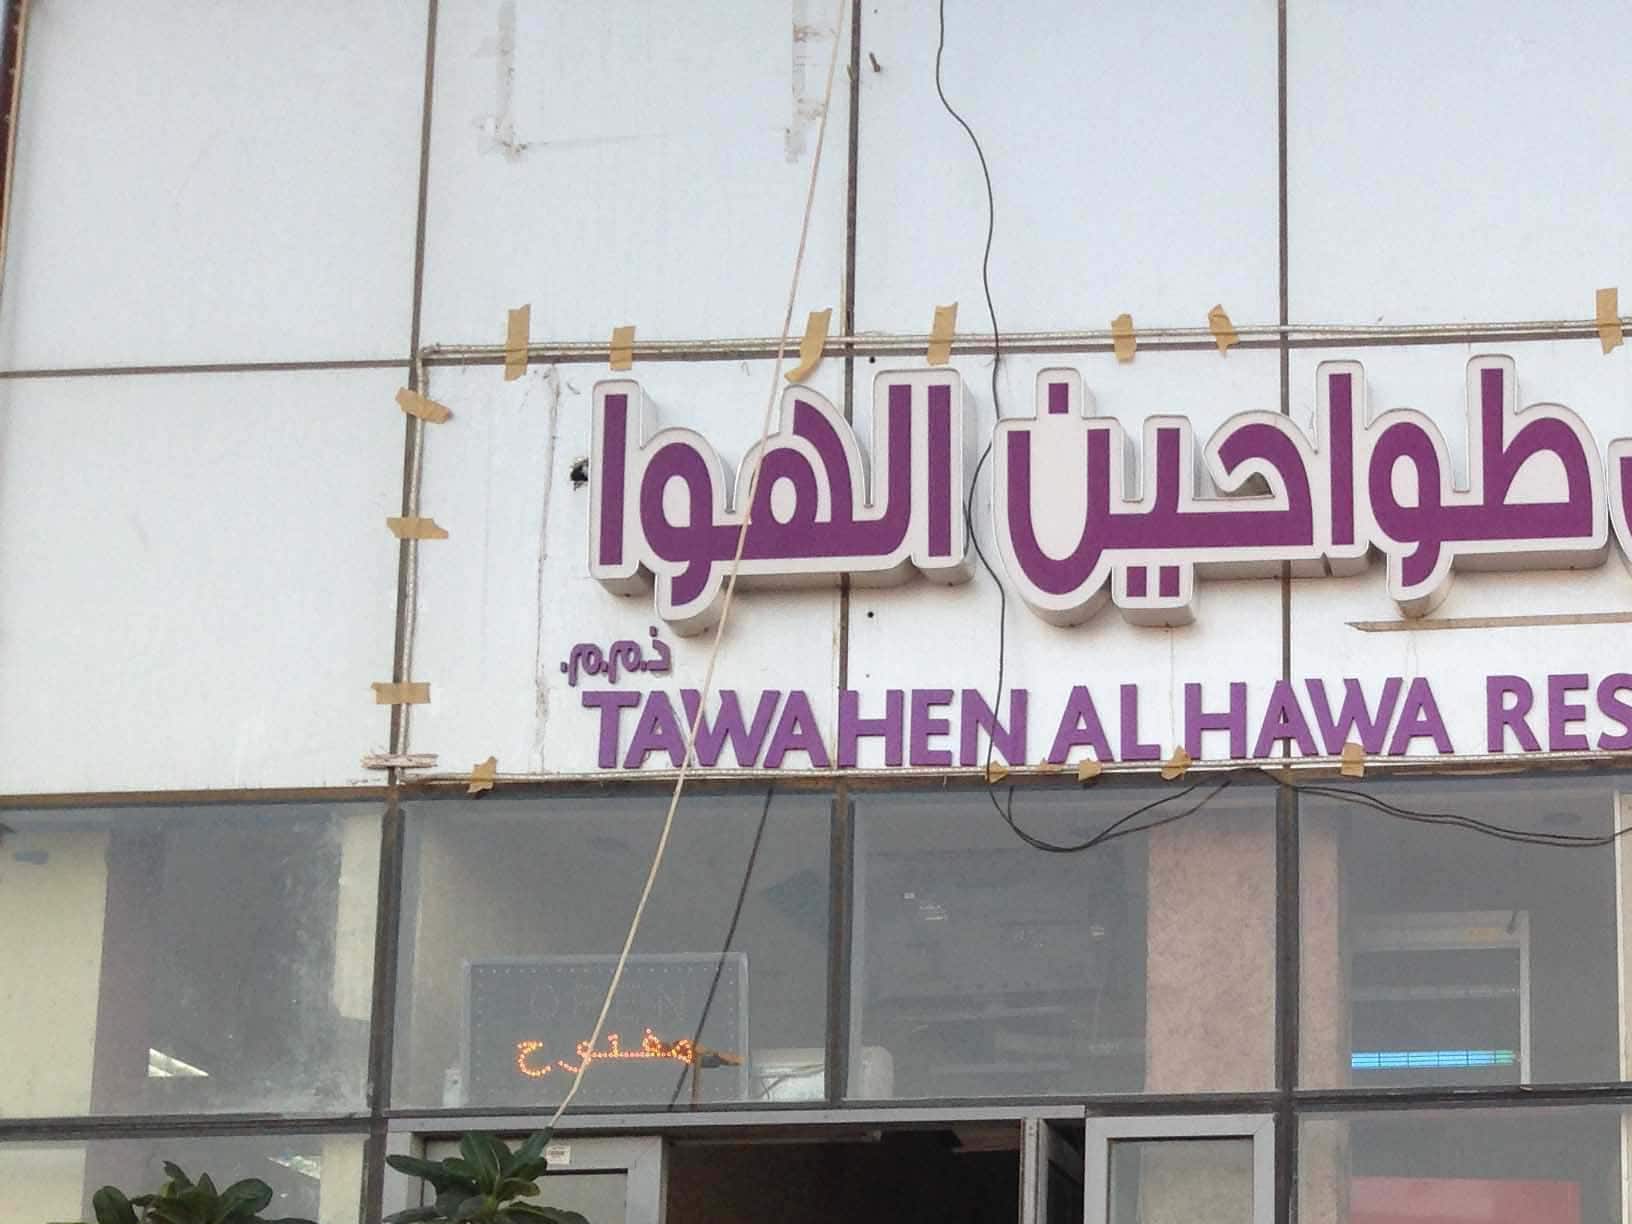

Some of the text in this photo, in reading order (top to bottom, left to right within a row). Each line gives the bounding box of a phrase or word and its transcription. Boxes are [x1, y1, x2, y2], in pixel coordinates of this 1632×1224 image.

[600, 383, 951, 606] الهوا
[1008, 367, 1594, 597] طواحين
[1048, 683, 1161, 764] AL
[1186, 675, 1454, 760] HAWA
